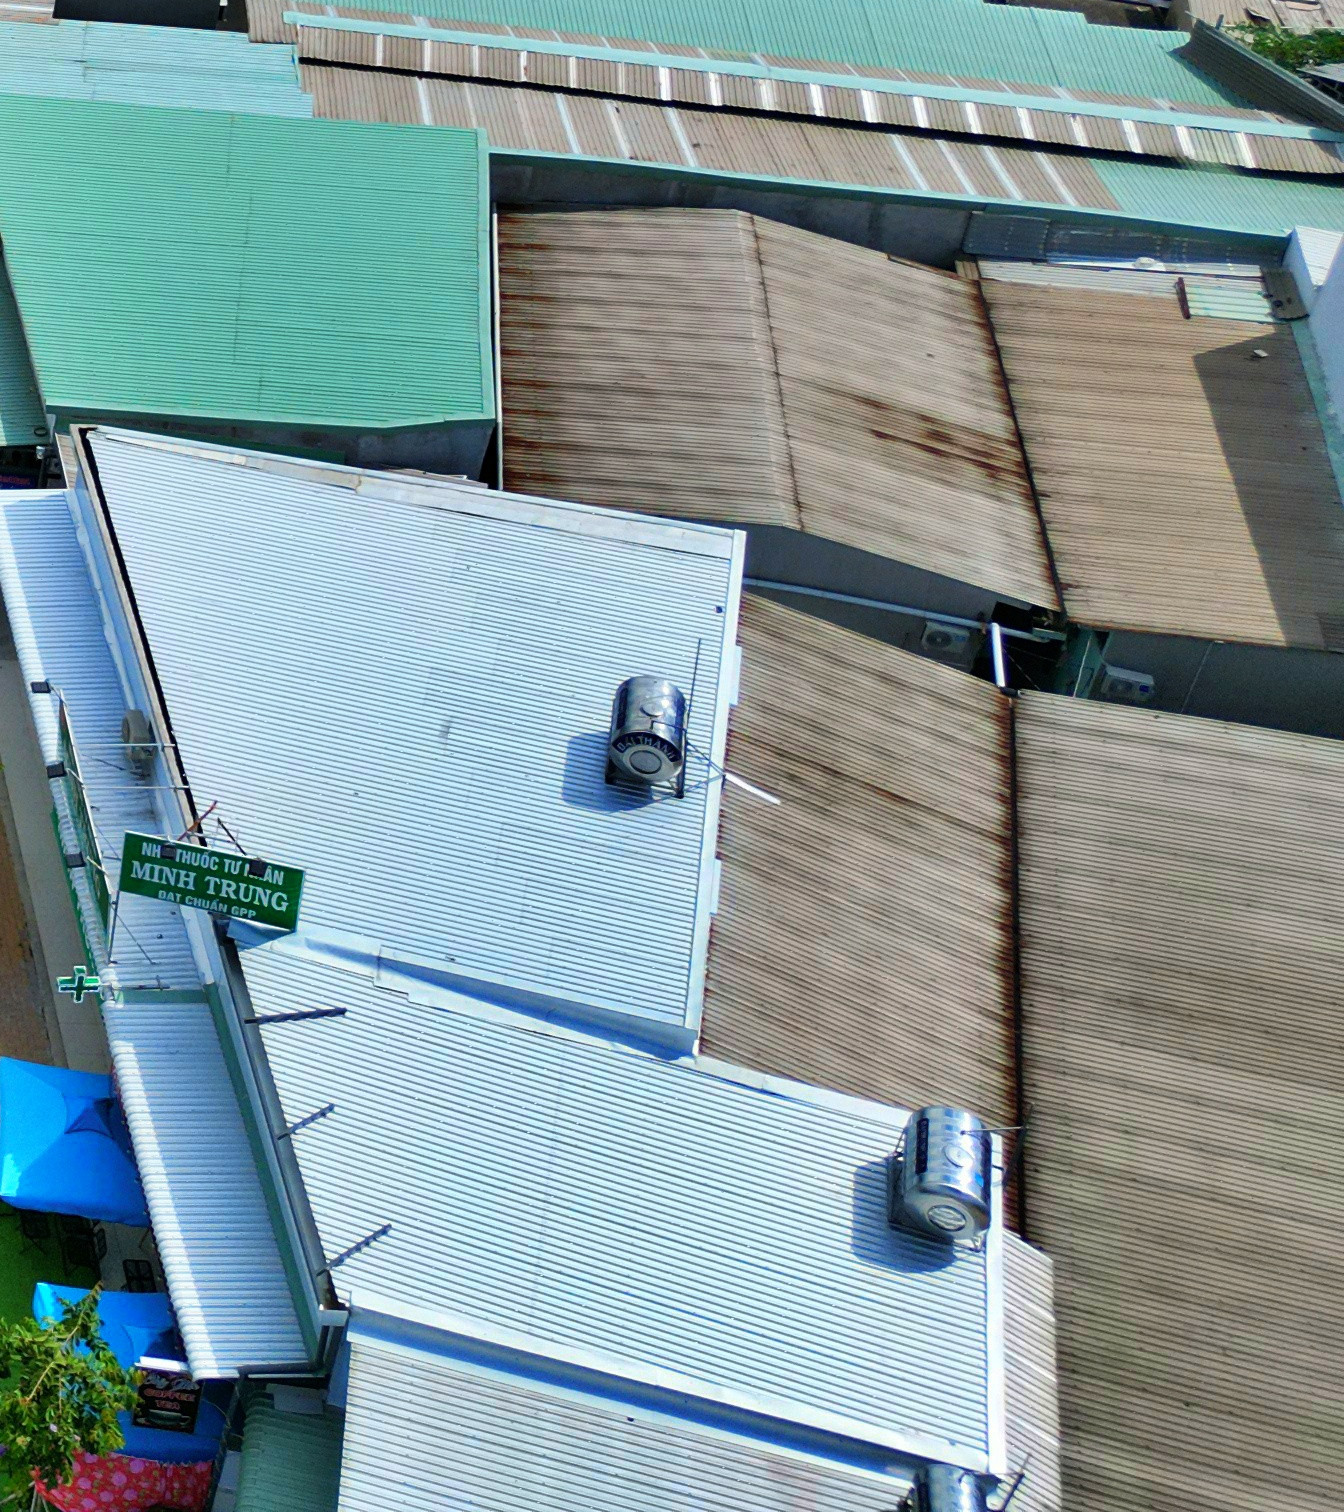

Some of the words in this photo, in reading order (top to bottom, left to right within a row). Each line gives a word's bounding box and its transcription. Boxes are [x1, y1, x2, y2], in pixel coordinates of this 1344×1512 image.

[130, 860, 197, 891] MINH
[204, 875, 289, 912] TRUNG
[175, 848, 220, 871] THUỐC
[224, 858, 243, 875] TƯ
[244, 863, 285, 886] ÂN
[231, 905, 257, 920] GPP
